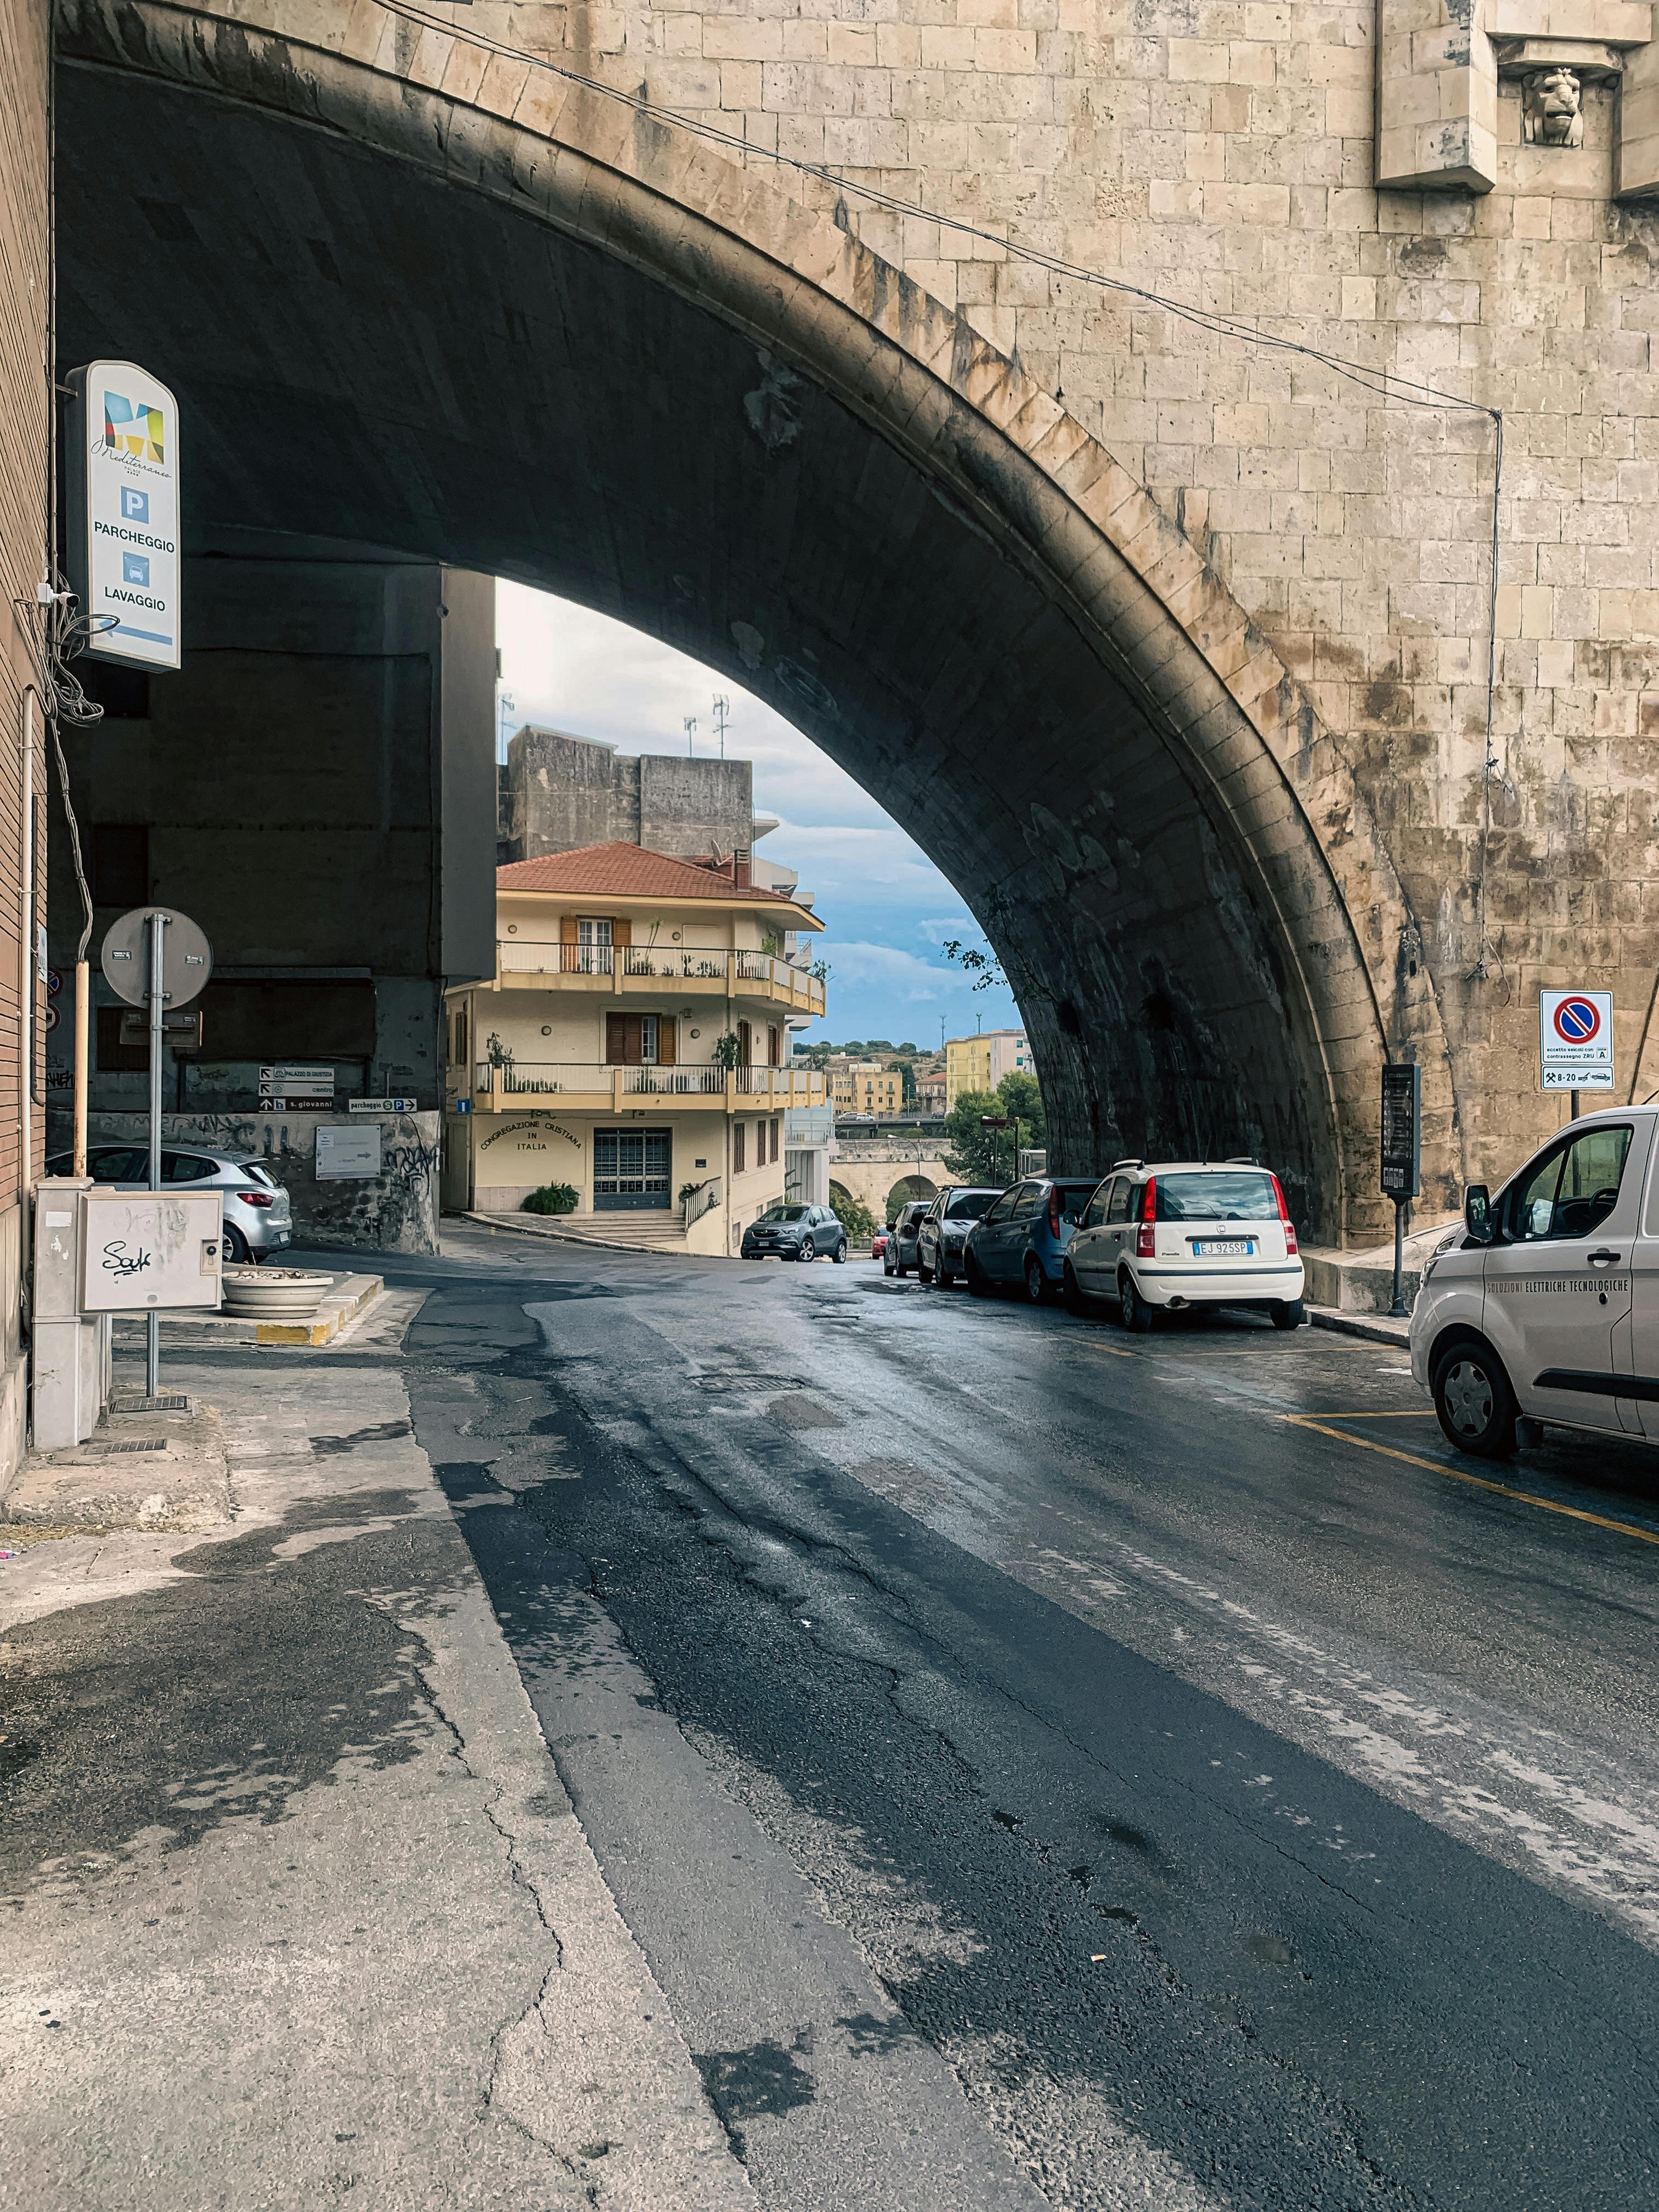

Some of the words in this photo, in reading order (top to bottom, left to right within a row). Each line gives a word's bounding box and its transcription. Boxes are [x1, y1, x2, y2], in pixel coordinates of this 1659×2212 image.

[126, 491, 144, 515] P
[94, 521, 174, 553] PARCHEGGIO
[105, 586, 165, 611] LAVAGGIO
[481, 1121, 540, 1150] CONGREGAZIONE
[545, 1122, 582, 1149] CRISTIANA
[1201, 1244, 1213, 1254] EJ
[1217, 1243, 1245, 1254] 925SP
[1487, 1282, 1522, 1294] SOLUZIONI
[1525, 1281, 1566, 1293] ELETTRICHE
[1570, 1279, 1628, 1292] TECNOLOGICHE
